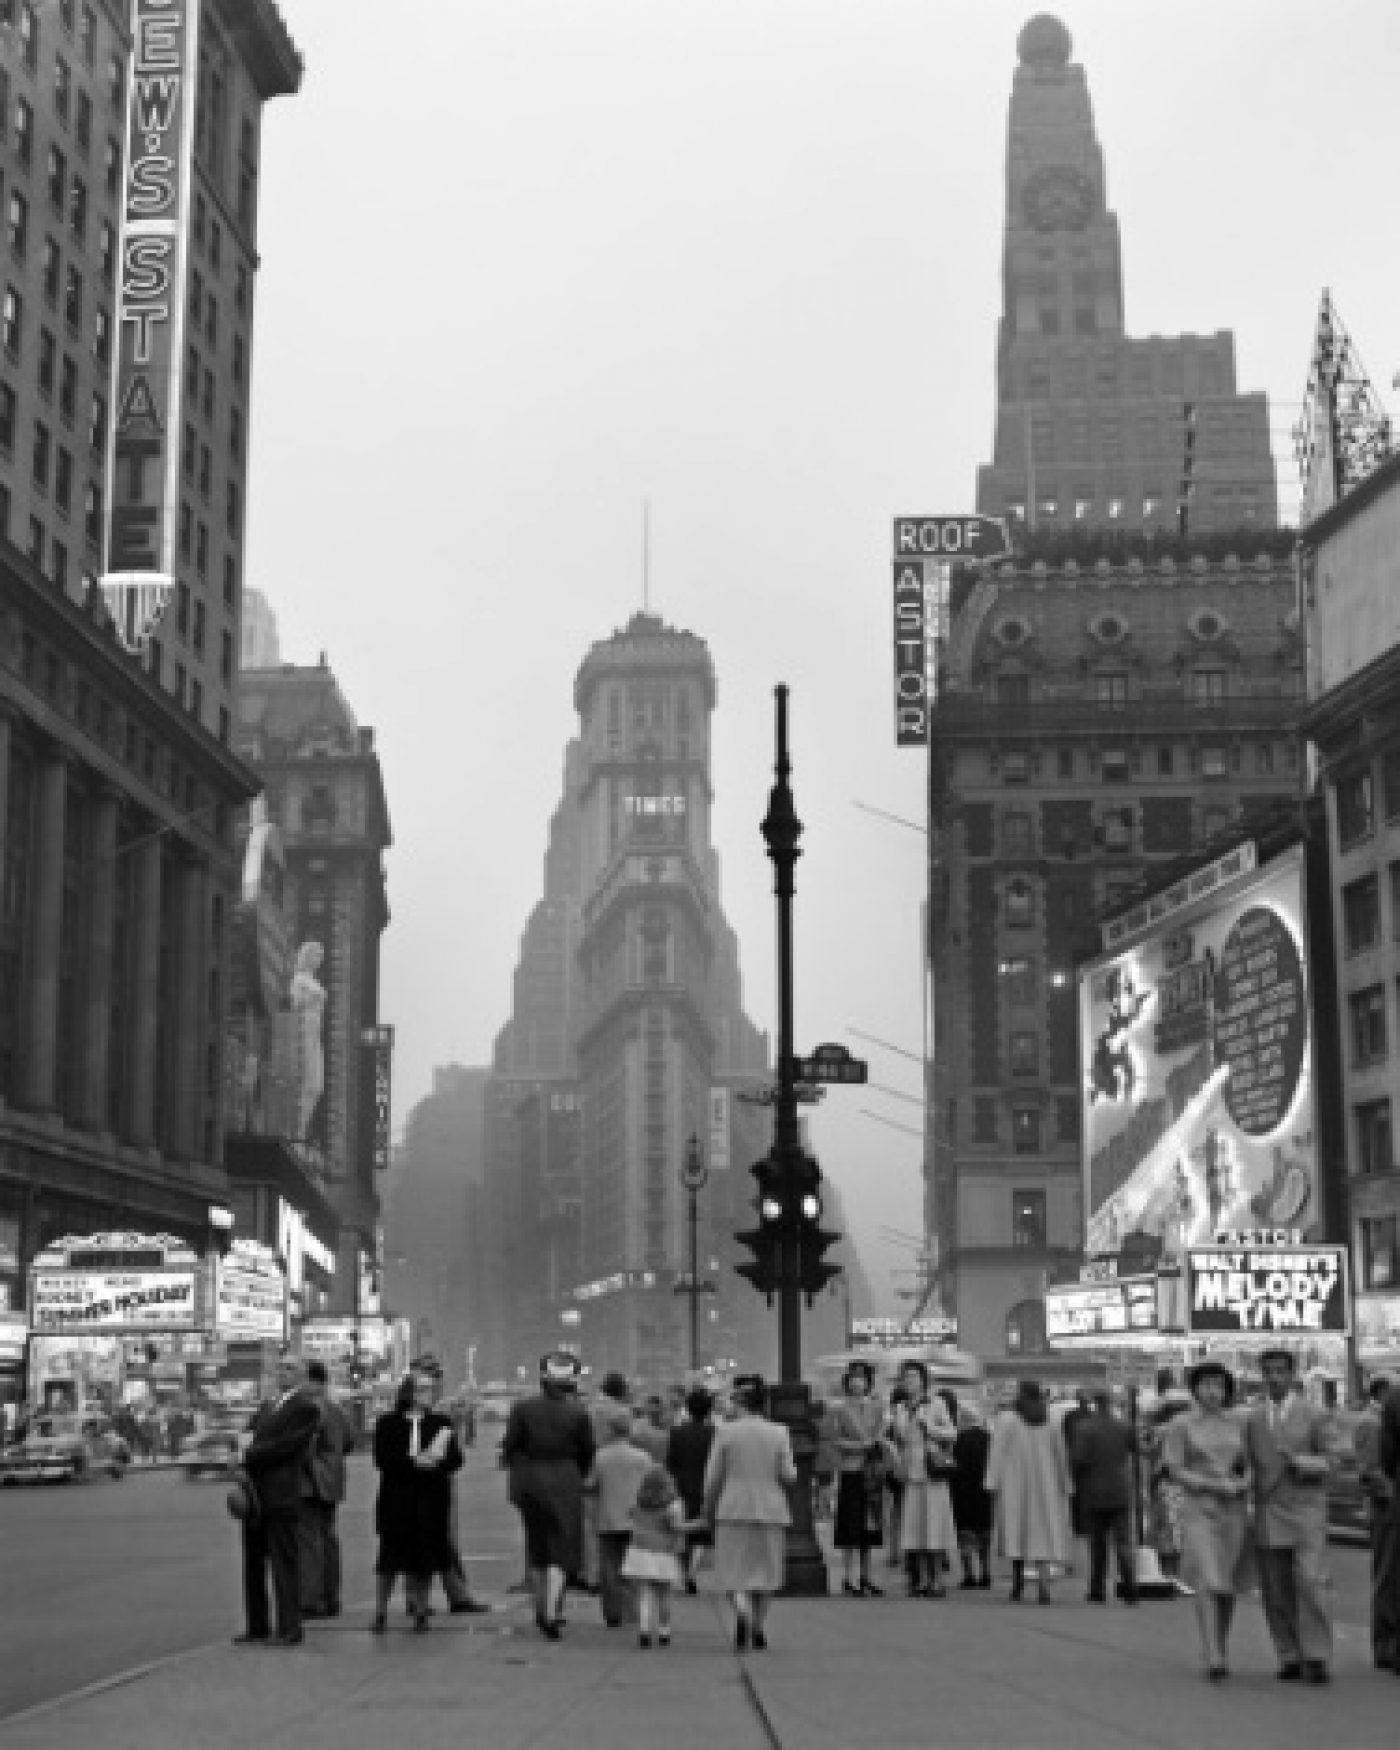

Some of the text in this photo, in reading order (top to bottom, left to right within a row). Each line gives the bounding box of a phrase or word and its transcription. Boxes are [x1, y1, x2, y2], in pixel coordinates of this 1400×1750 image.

[114, 238, 169, 571] STATE
[900, 519, 979, 551] ROOF
[897, 565, 924, 734] ASTOR
[624, 796, 686, 816] TIMES
[1194, 1271, 1338, 1311] MELODY
[1228, 1299, 1324, 1329] TIME
